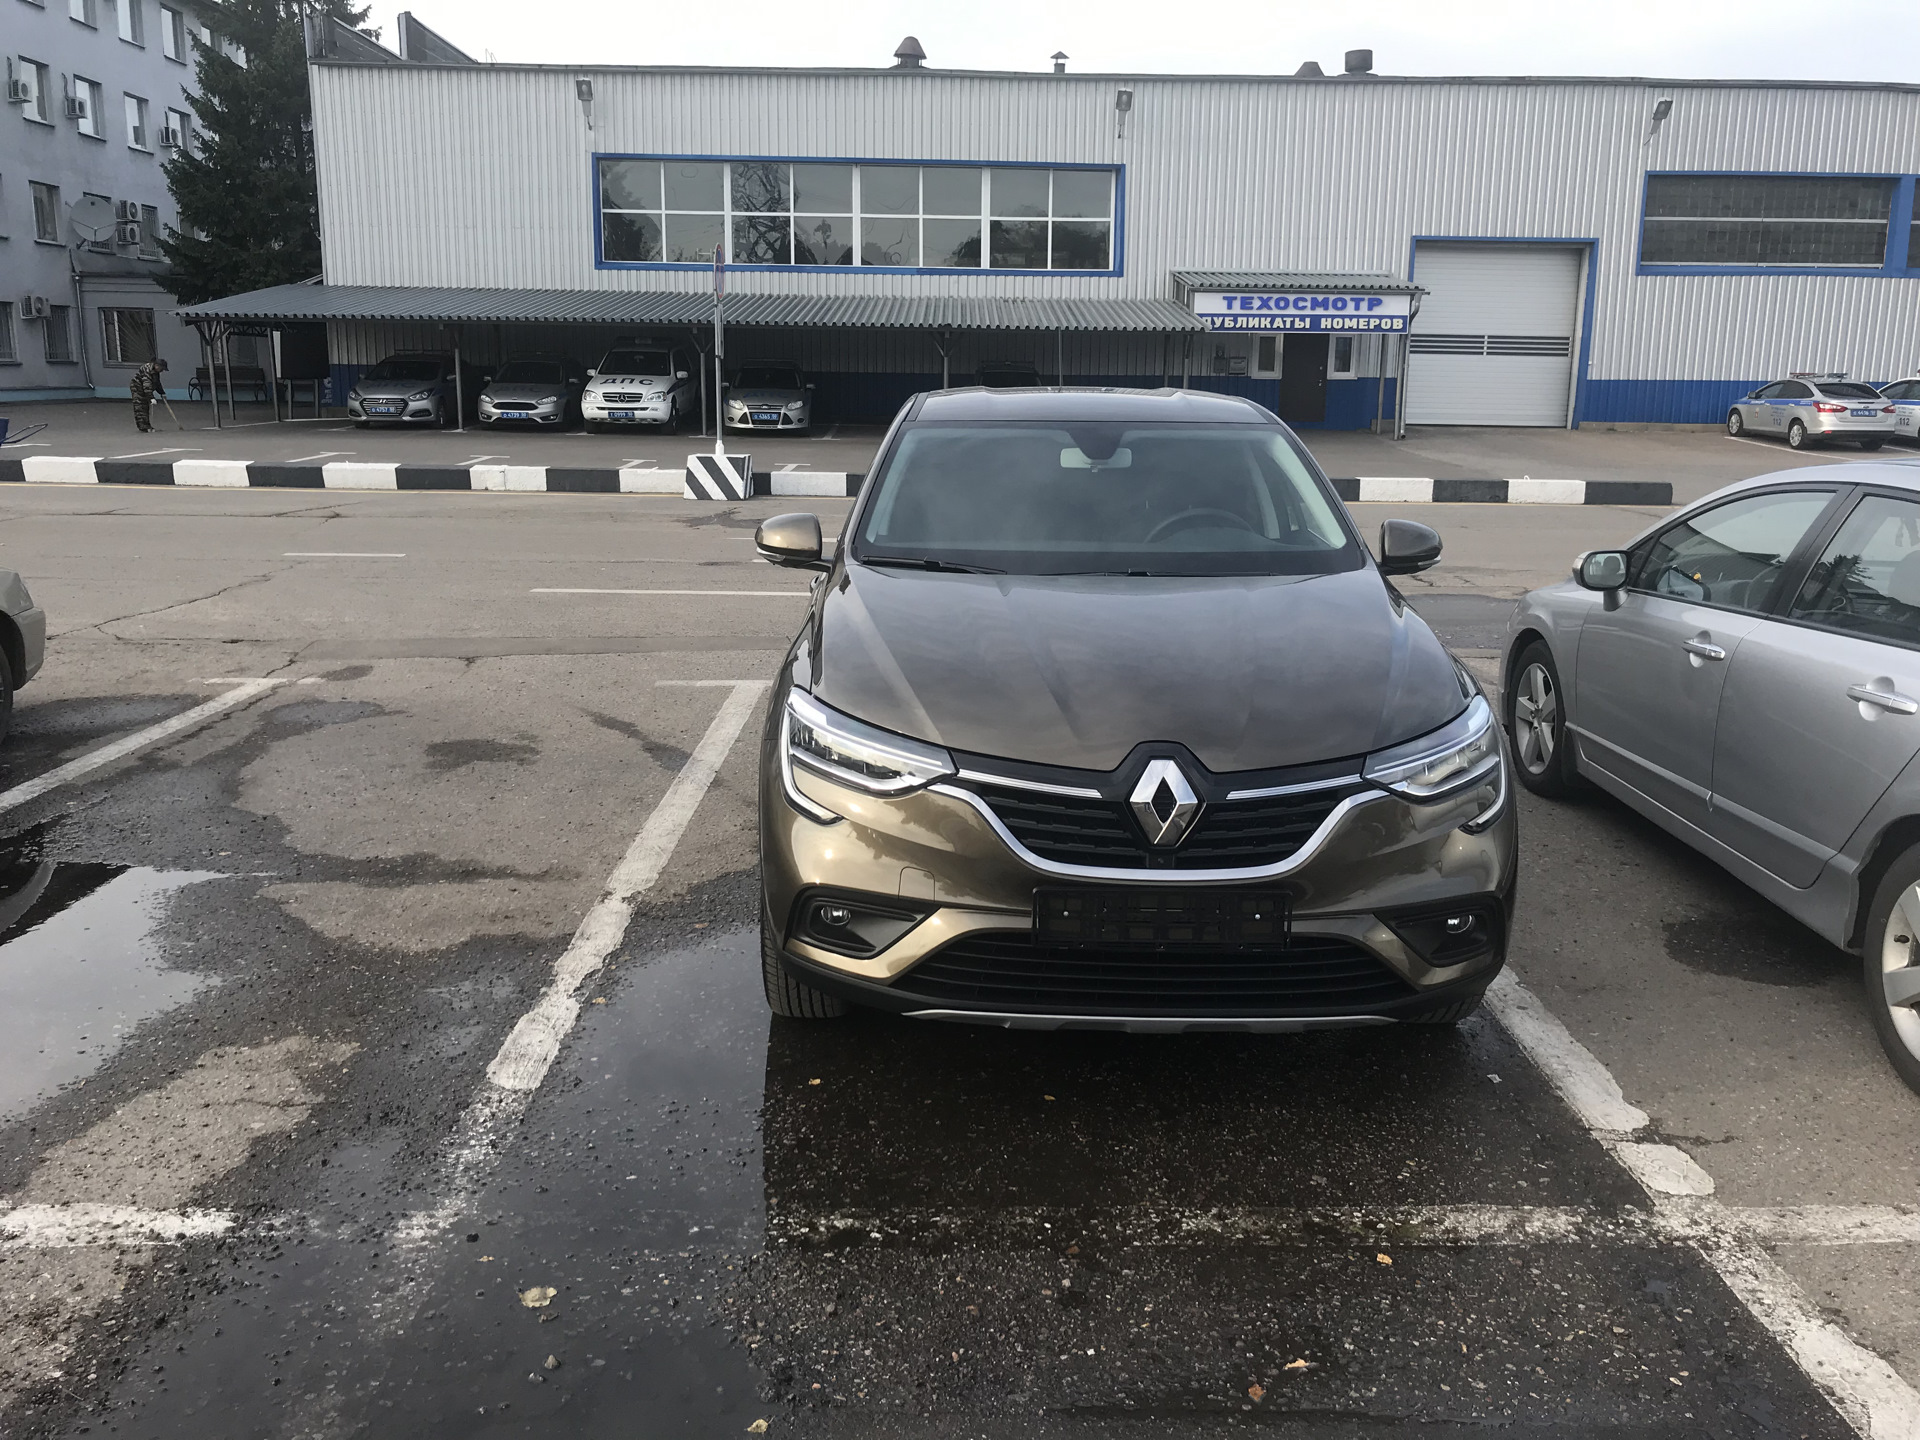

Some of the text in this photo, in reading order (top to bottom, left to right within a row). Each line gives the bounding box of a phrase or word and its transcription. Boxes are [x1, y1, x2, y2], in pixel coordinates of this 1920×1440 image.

[1222, 296, 1383, 311] ТЕХОСМОТР
[1320, 318, 1404, 329] НОМЕРОВ
[600, 377, 654, 386] ДПС
[1899, 418, 1910, 426] 112
